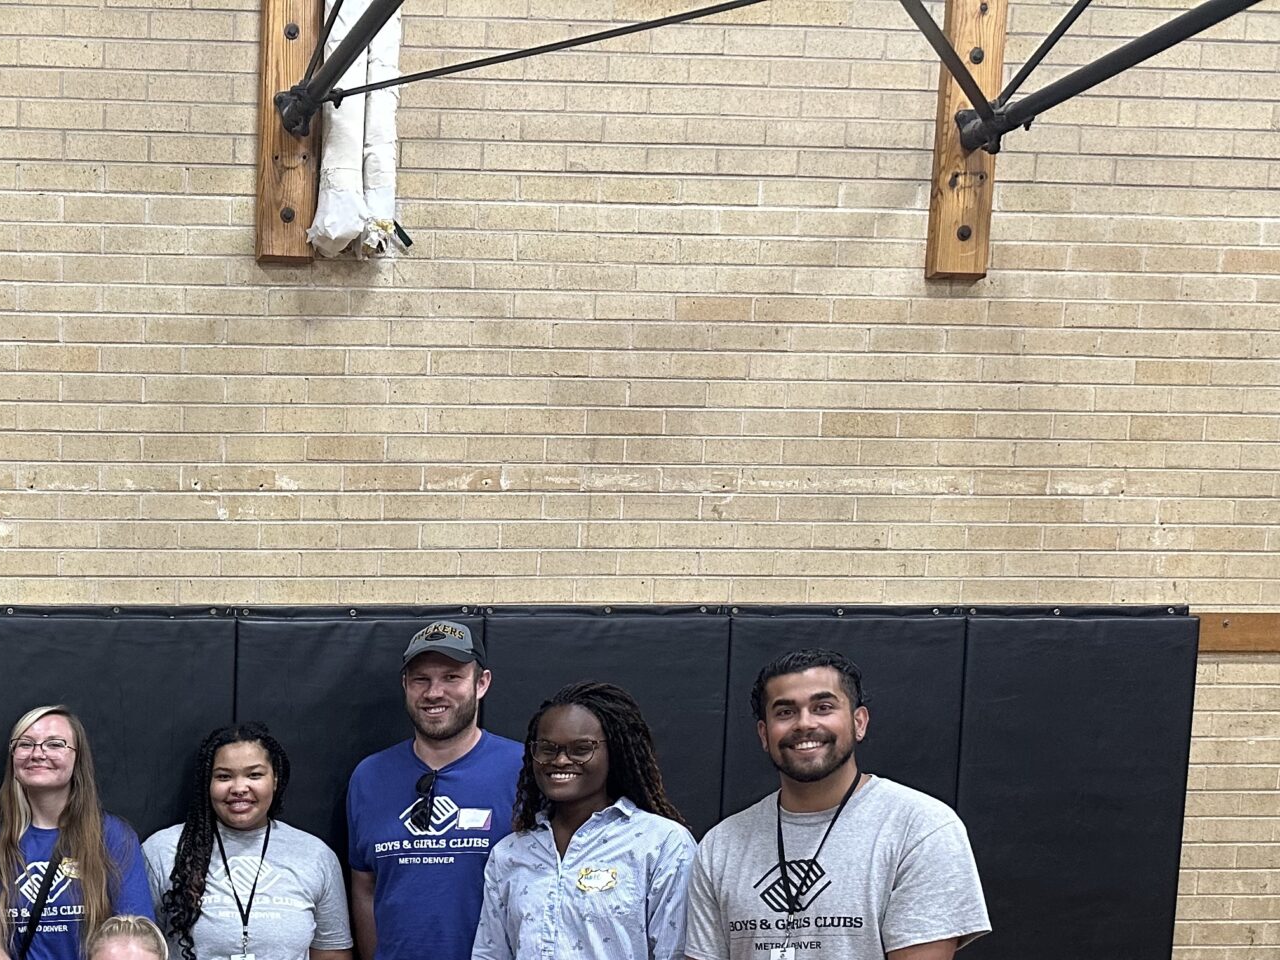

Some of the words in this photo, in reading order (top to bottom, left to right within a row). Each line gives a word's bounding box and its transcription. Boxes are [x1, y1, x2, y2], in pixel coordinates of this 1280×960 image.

[375, 840, 401, 853] BOYS
[402, 840, 412, 849] &
[413, 839, 447, 849] GIRLS
[449, 838, 490, 849] CLUBS
[398, 857, 421, 865] METRO
[422, 856, 455, 865] DENVER
[43, 924, 69, 933] DENVER
[729, 919, 758, 932] BOYS
[760, 919, 771, 930] &
[815, 916, 864, 929] CLUBS
